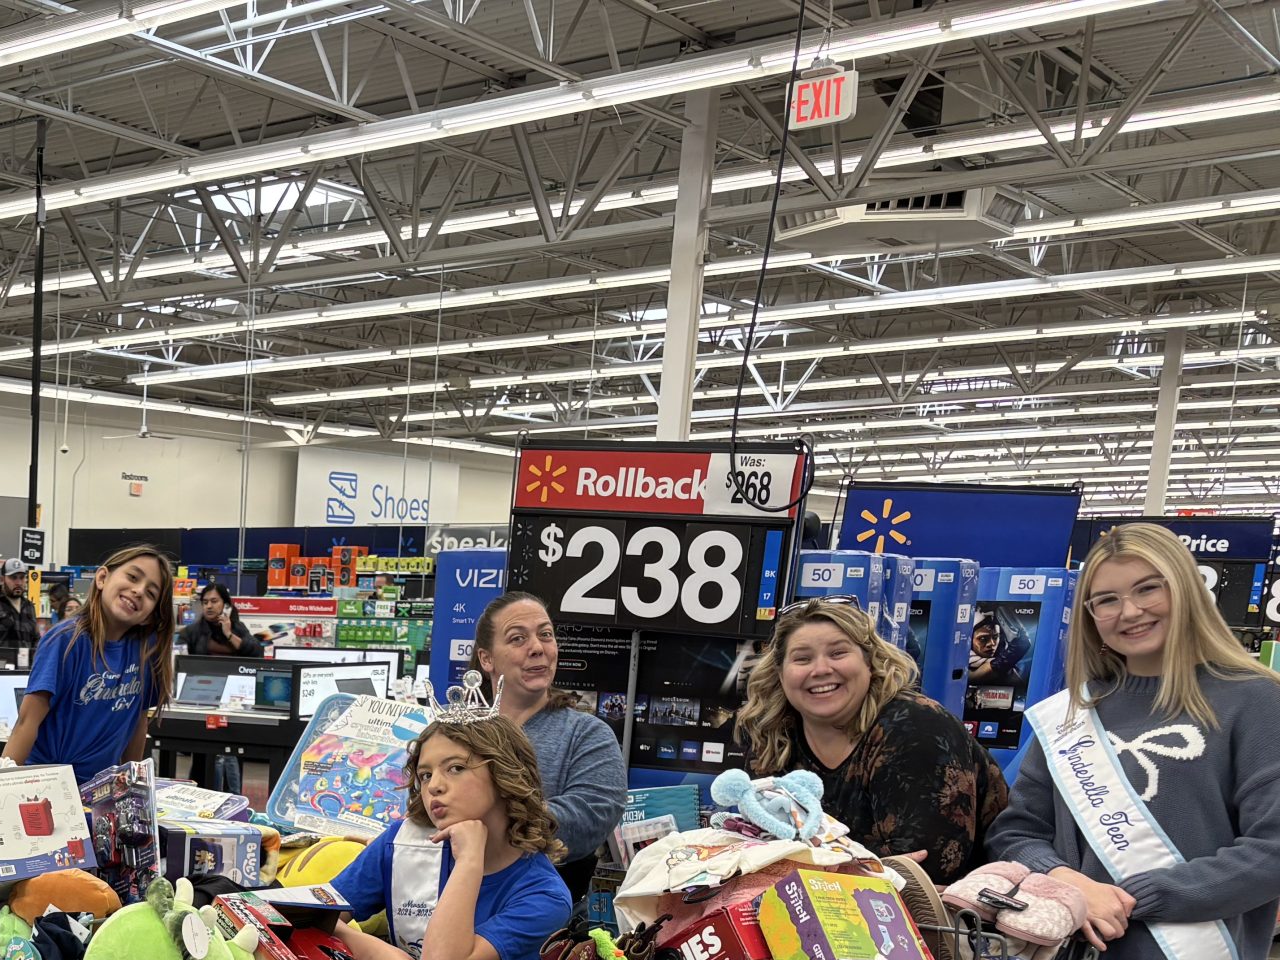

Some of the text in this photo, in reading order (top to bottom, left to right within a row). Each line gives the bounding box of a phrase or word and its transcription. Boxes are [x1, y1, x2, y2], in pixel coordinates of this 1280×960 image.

[796, 76, 846, 123] EXIT
[740, 455, 766, 468] Was:
[576, 466, 708, 500] Rollback
[725, 471, 771, 505] $268
[371, 484, 429, 522] Shoes
[1179, 535, 1230, 552] Price
[455, 568, 504, 589] VIZI
[538, 523, 744, 625] $238
[764, 570, 776, 578] BK
[452, 602, 466, 613] 4K
[1058, 734, 1111, 809] Cinderella
[1099, 811, 1135, 852] Teen
[396, 908, 434, 917] 2024-2025
